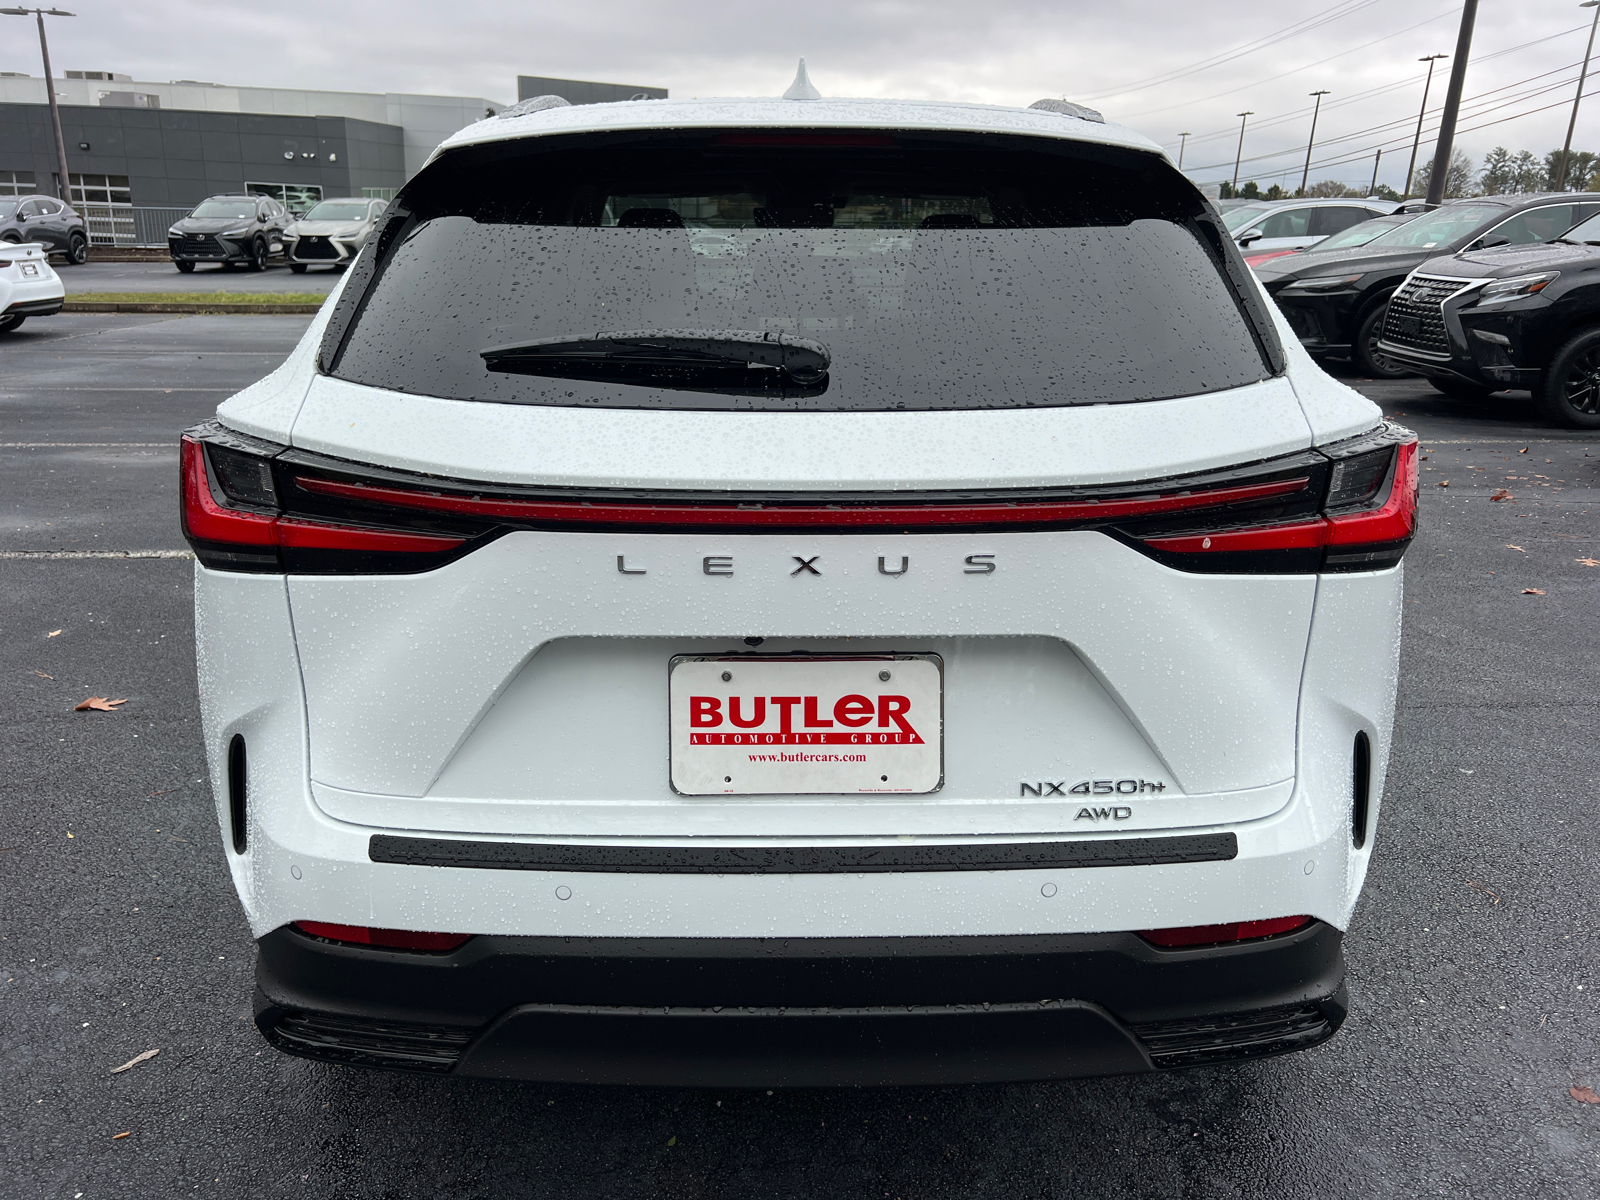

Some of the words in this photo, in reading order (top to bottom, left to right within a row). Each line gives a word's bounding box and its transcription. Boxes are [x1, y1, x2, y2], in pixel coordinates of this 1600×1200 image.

[617, 554, 996, 576] LEXUS
[691, 734, 827, 744] AUTOMOTIVE
[850, 733, 917, 744] GROUP
[748, 751, 867, 762] www.butlercars.com
[1073, 806, 1132, 820] AWD
